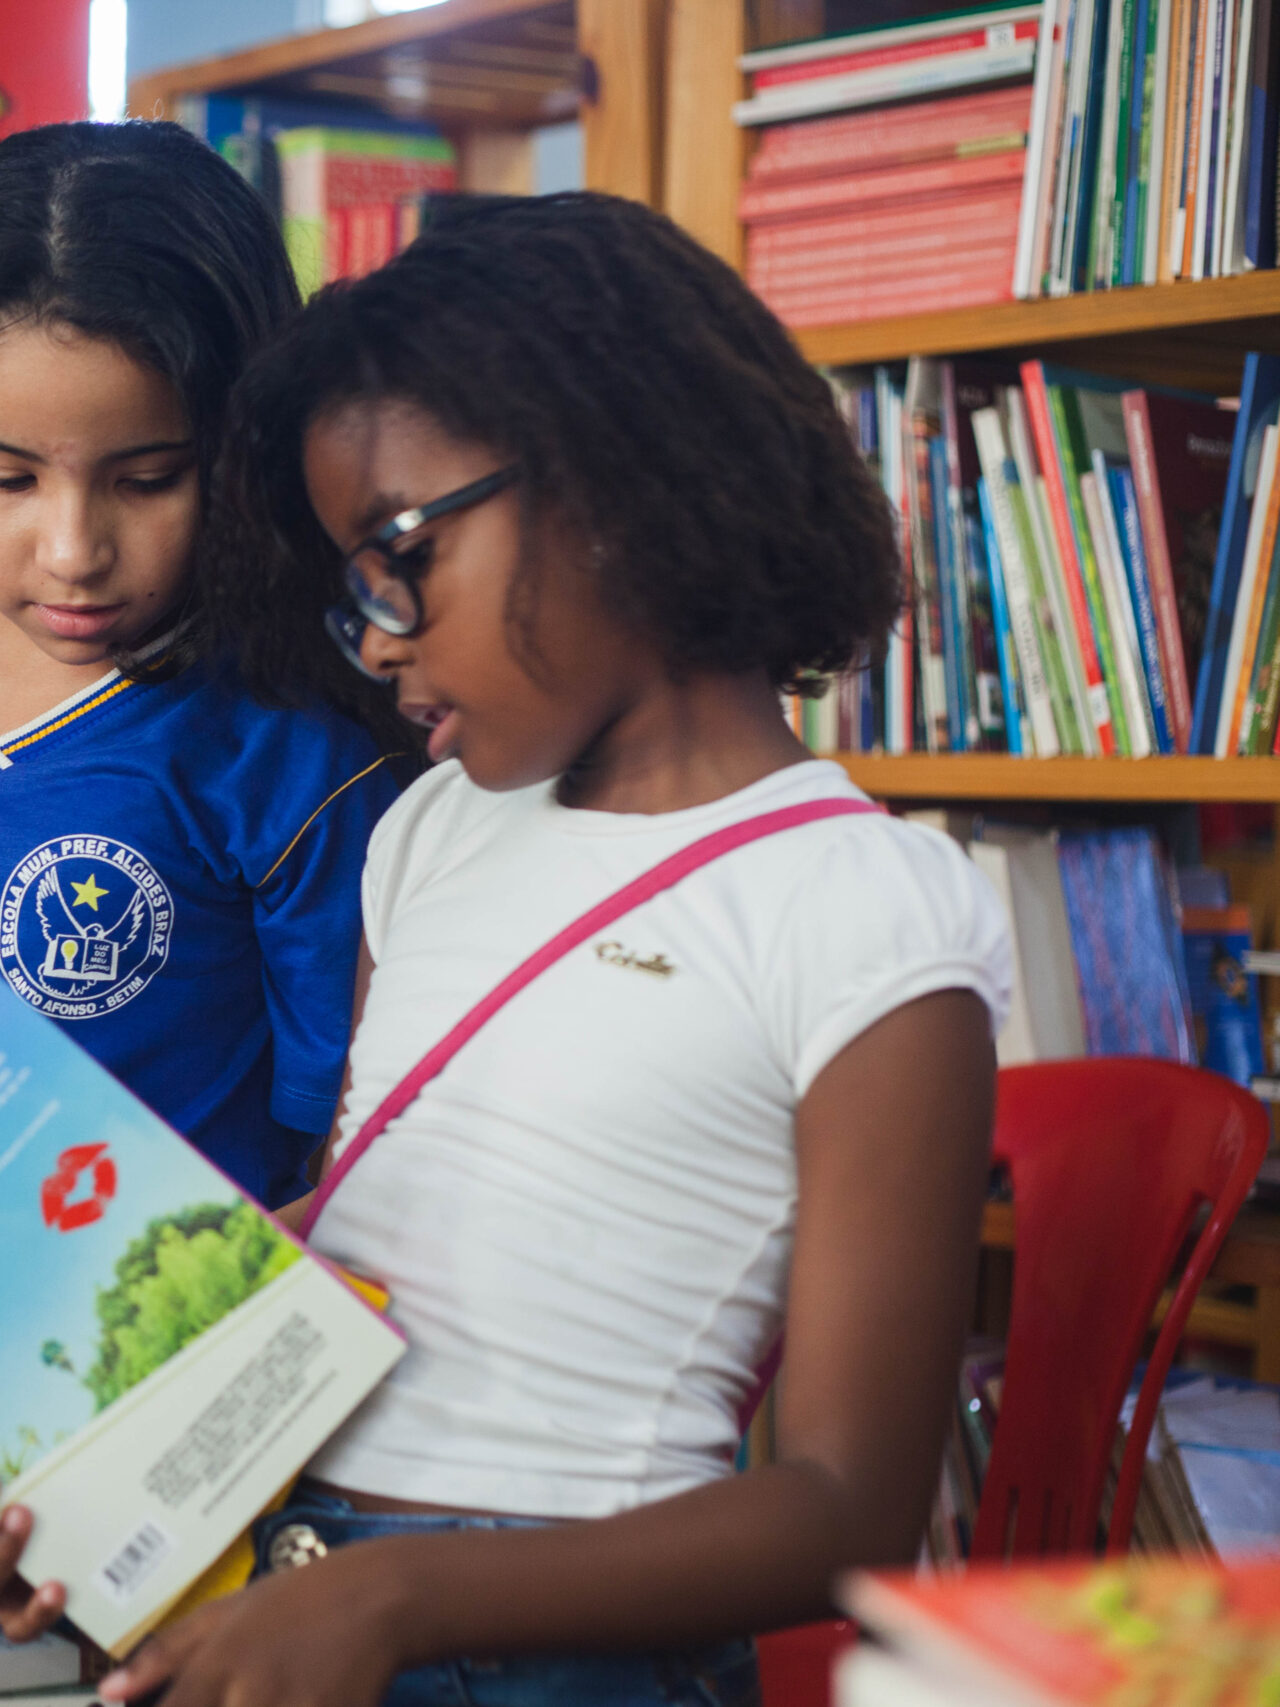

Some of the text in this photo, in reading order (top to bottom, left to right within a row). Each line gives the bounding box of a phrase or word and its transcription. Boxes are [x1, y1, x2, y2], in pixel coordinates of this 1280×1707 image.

[1, 838, 170, 958] ESCOLA MUN. PREF. ALCIDES BRAZ
[8, 967, 43, 1005] SANTO
[42, 999, 97, 1016] AFONSO
[106, 976, 144, 1008] BETIM
